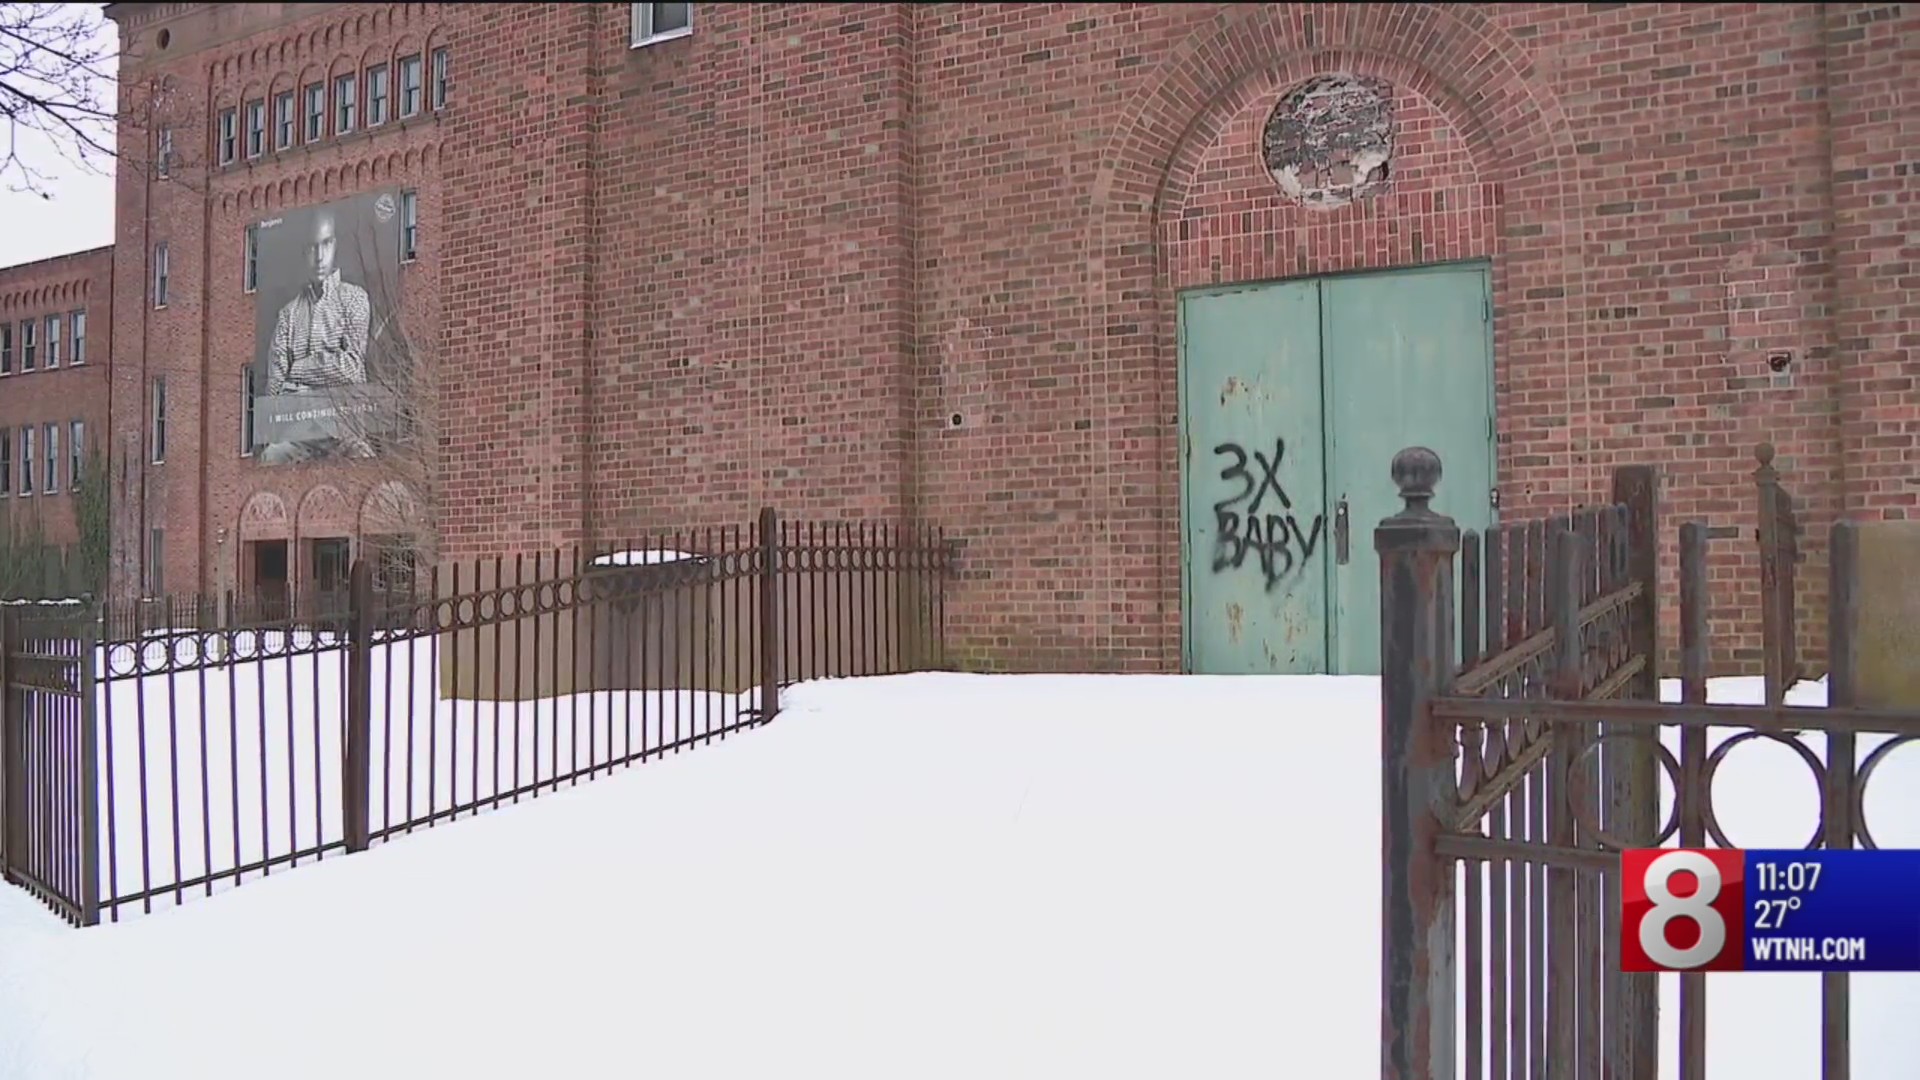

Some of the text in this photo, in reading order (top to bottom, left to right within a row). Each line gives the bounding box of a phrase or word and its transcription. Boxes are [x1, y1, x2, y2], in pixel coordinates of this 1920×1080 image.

[275, 412, 293, 423] WILL
[1213, 436, 1292, 515] 3X
[1212, 511, 1323, 594] BABY
